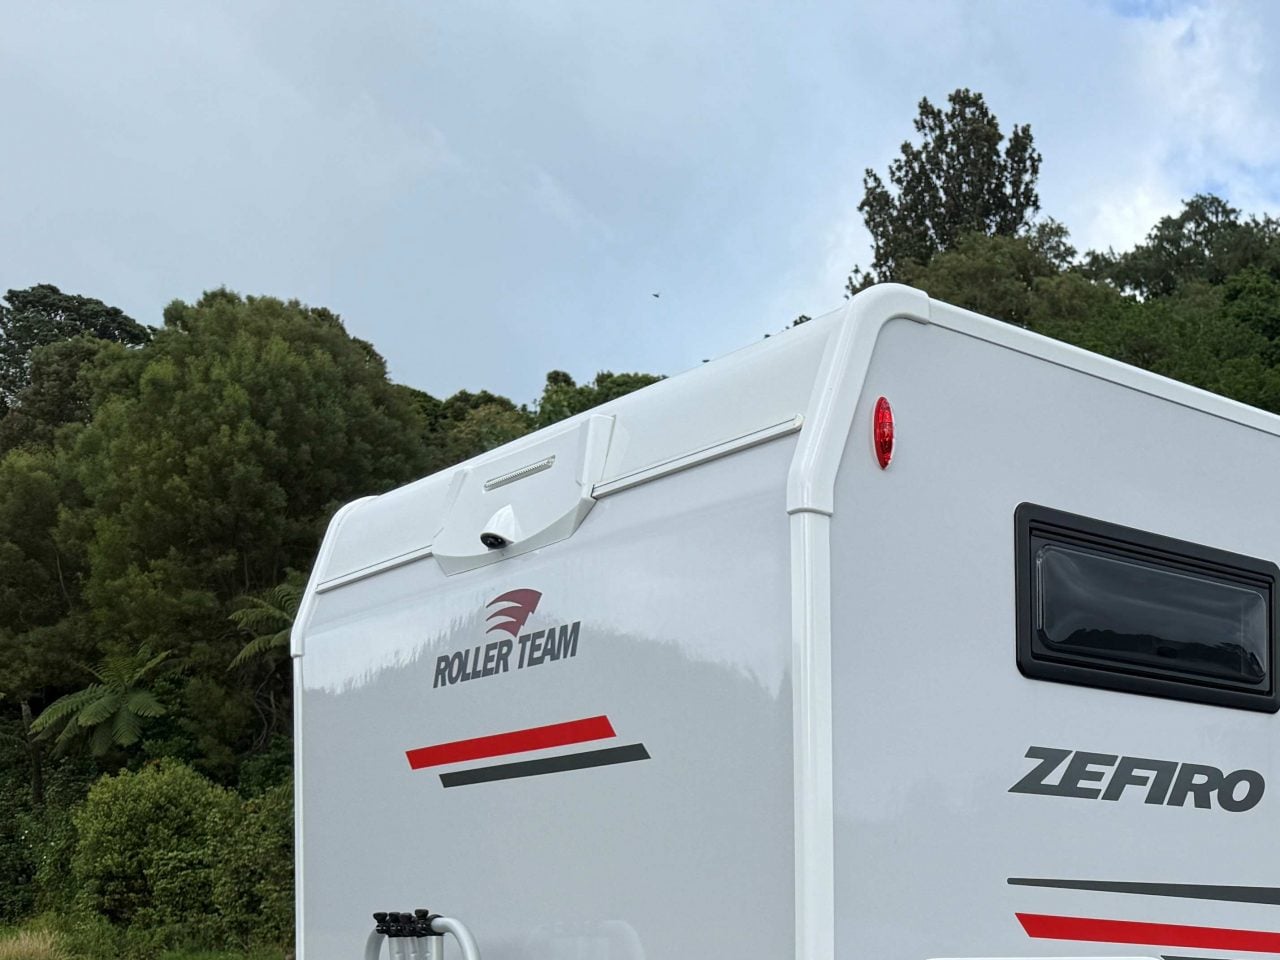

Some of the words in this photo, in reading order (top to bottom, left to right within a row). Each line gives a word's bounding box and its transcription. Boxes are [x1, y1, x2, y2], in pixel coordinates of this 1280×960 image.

[433, 638, 513, 689] ROLLER
[518, 621, 581, 670] TEAM
[1007, 745, 1266, 813] ZEFIRO
